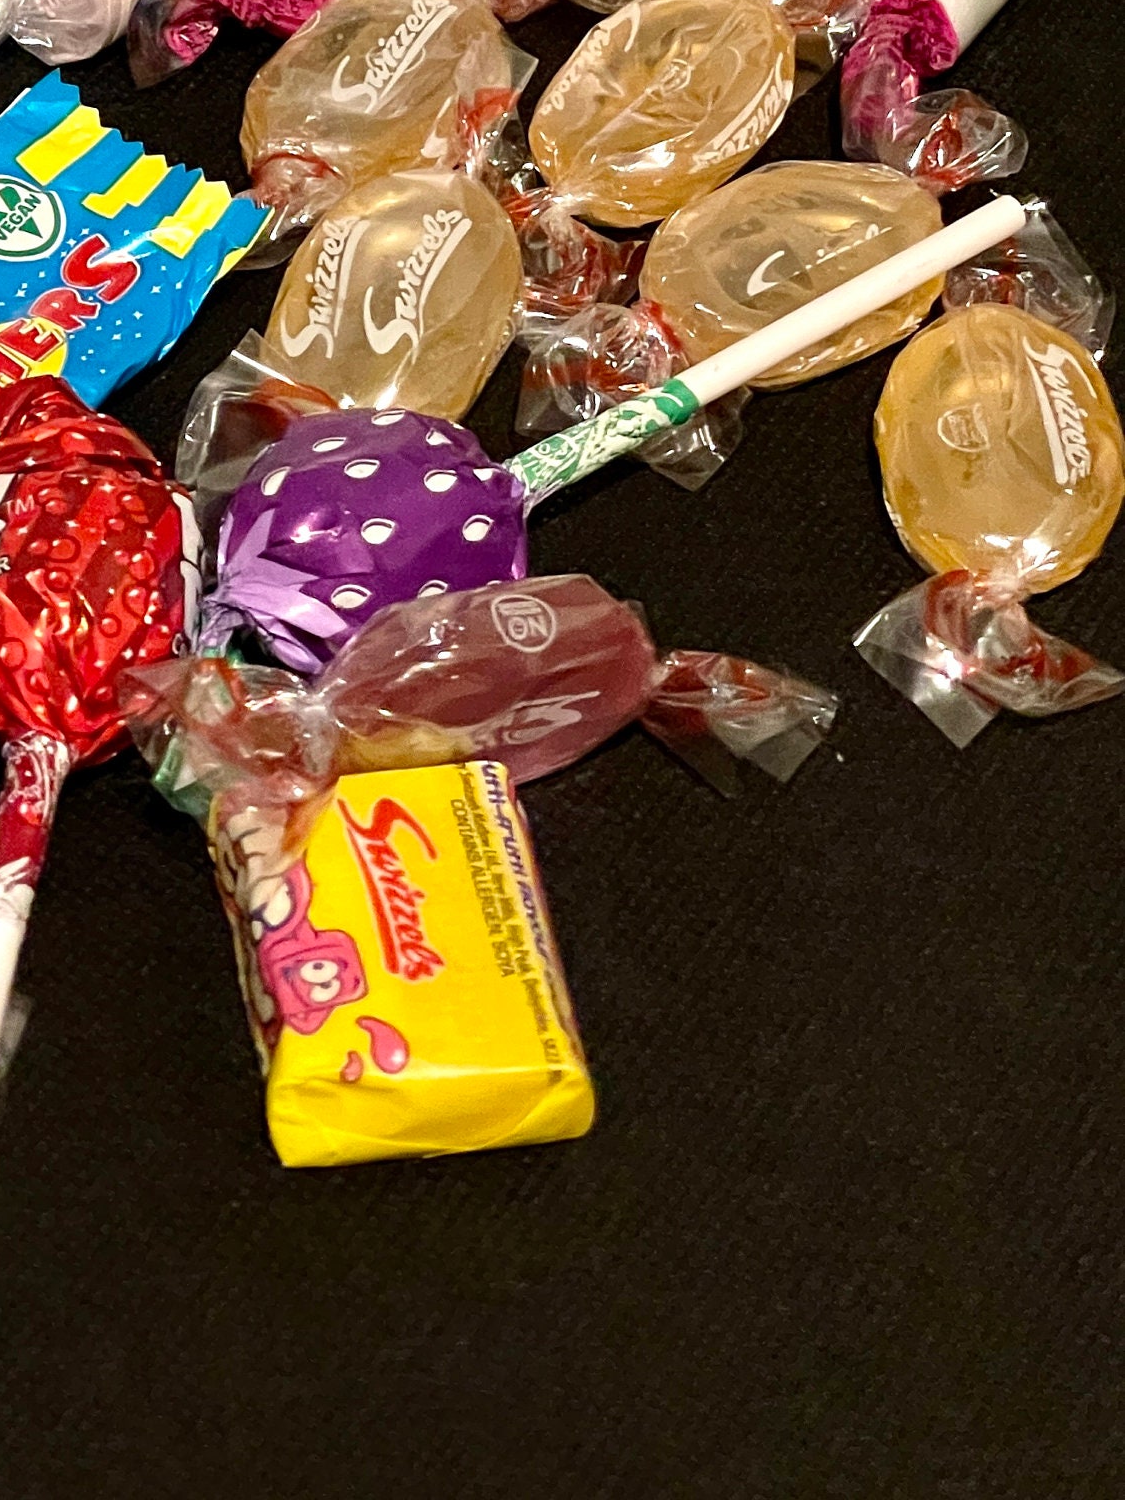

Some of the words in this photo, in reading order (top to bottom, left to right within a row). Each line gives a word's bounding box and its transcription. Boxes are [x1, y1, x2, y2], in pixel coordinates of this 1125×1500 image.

[280, 214, 372, 360] Swizzels
[363, 208, 473, 366] Swizzels
[1021, 335, 1098, 487] Swizzels
[337, 796, 445, 984] Swizzels
